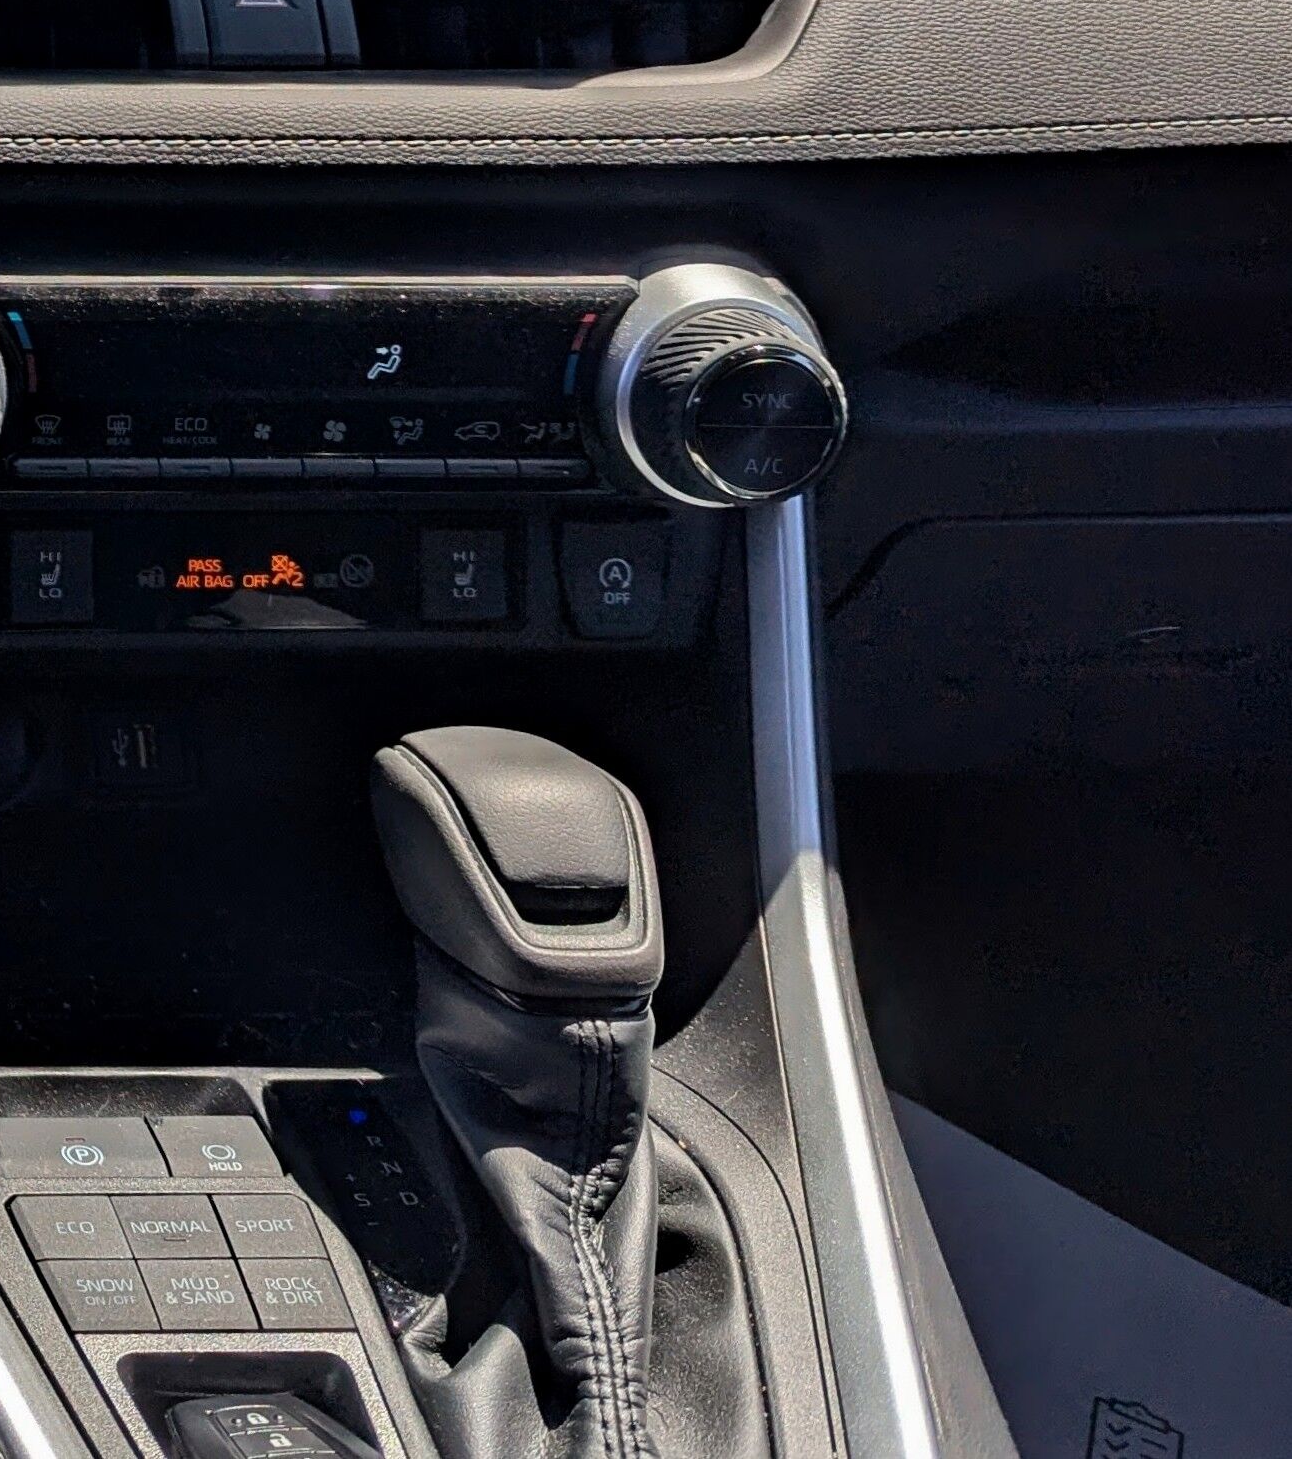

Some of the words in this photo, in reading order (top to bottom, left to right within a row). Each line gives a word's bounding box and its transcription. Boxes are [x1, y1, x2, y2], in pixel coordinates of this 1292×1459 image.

[742, 393, 792, 409] SYNC
[174, 417, 208, 432] ECO
[743, 457, 784, 476] A/C
[40, 551, 61, 562] HI
[453, 551, 475, 561] HI
[188, 558, 222, 572] PASS
[175, 574, 201, 588] AIR
[204, 574, 234, 588] BAG
[242, 574, 269, 588] OFF
[39, 588, 62, 599] LO
[453, 588, 477, 598] LO
[604, 591, 631, 605] OFF
[366, 1135, 383, 1148] R
[208, 1161, 243, 1172] HOLD
[381, 1161, 403, 1175] N
[353, 1192, 371, 1208] S
[399, 1190, 419, 1206] D
[55, 1221, 95, 1235] ECO
[129, 1220, 212, 1234] NORMAL
[235, 1218, 295, 1233] SPORT
[76, 1278, 134, 1293] SNOW
[171, 1277, 220, 1290] MUD
[264, 1277, 316, 1290] ROCK
[165, 1292, 179, 1305] &
[187, 1290, 235, 1305] SAND
[265, 1292, 278, 1305] &
[282, 1291, 324, 1306] DIRT
